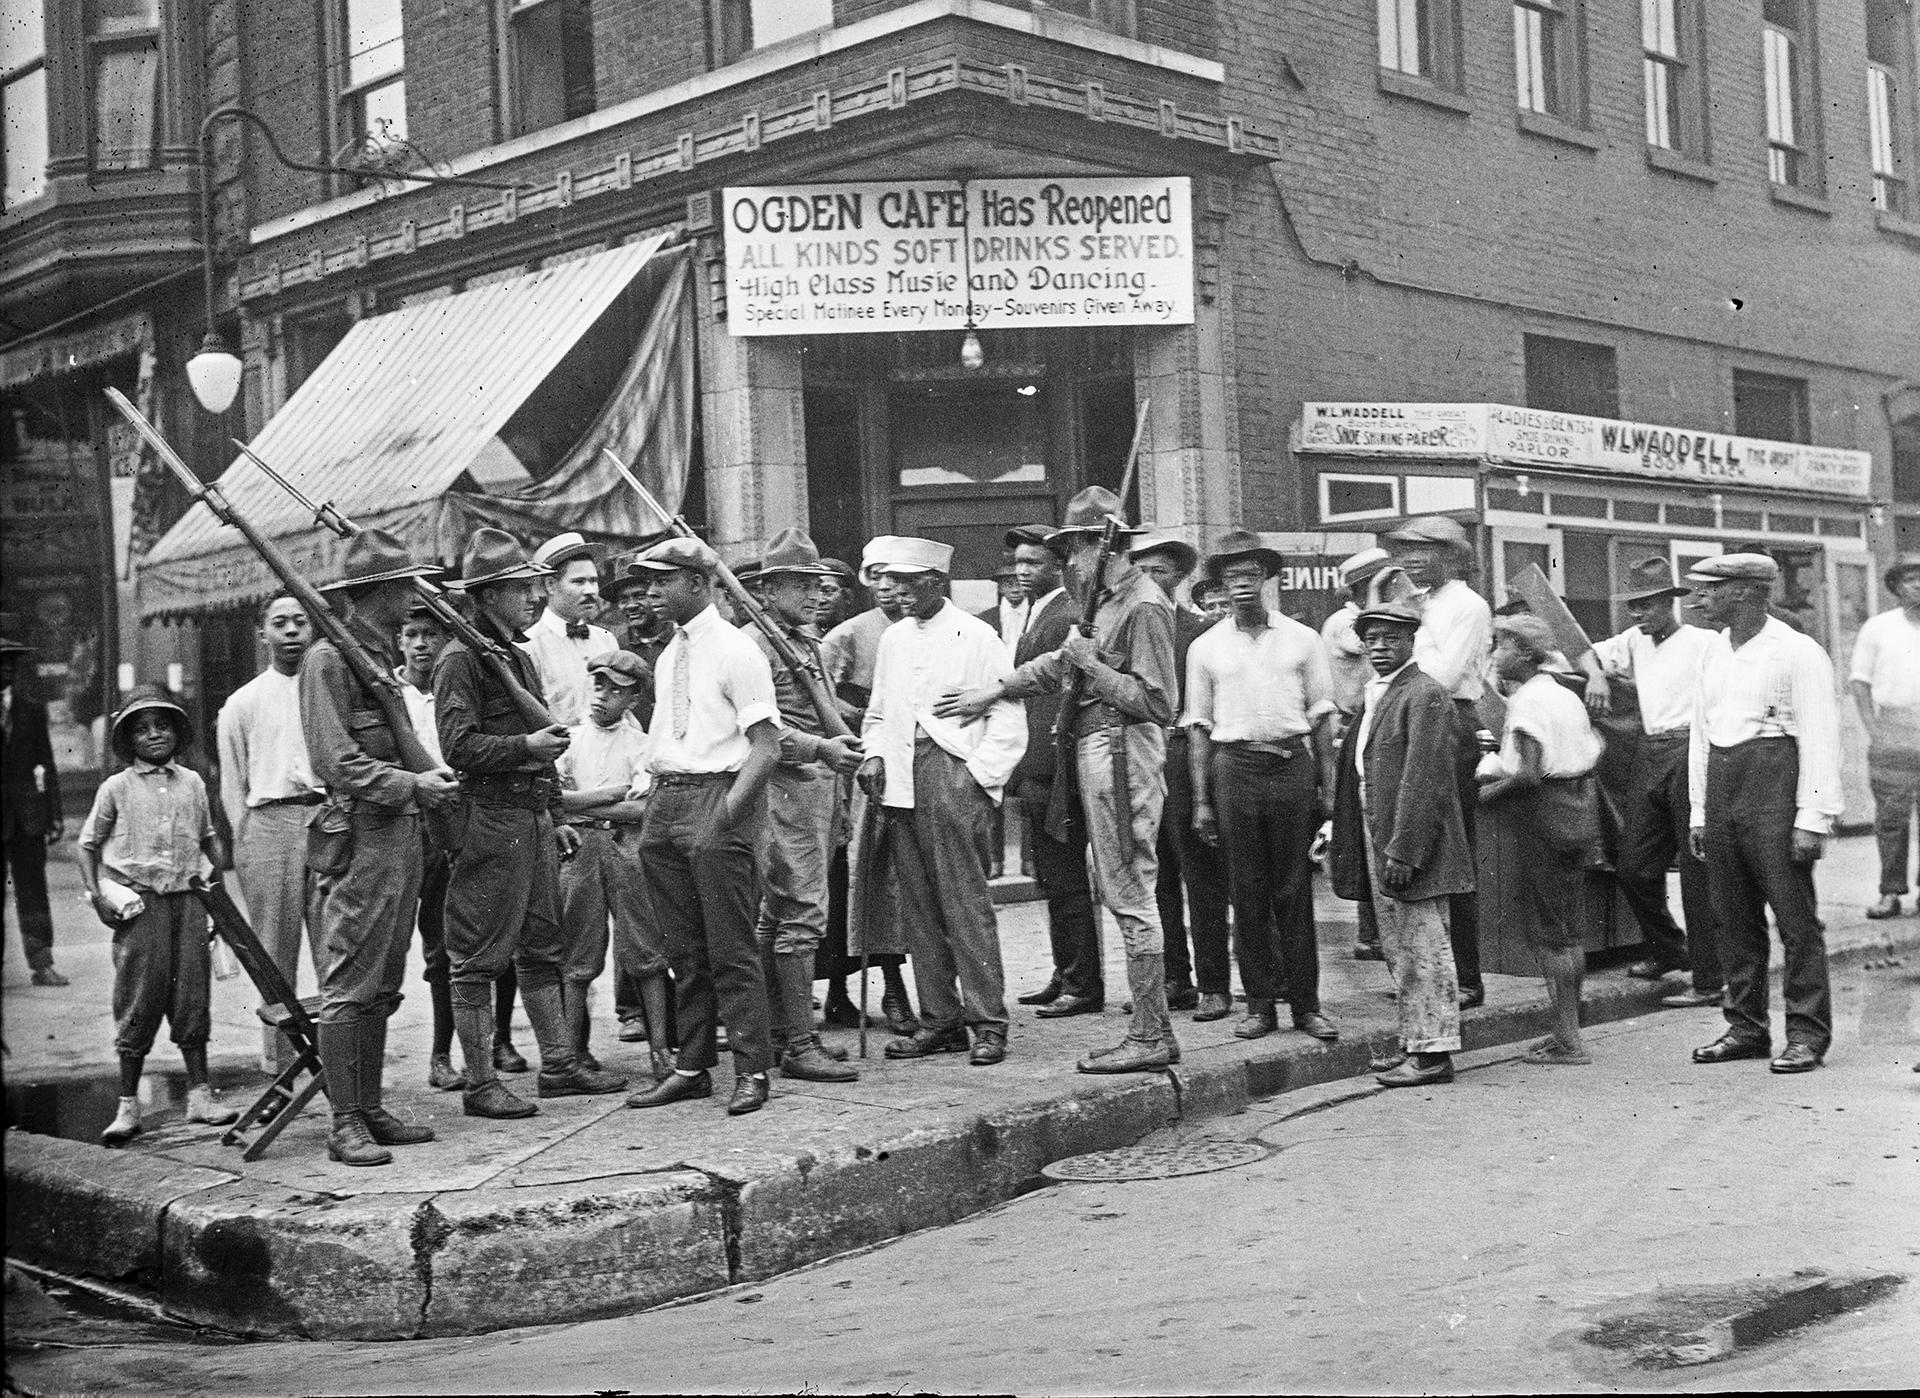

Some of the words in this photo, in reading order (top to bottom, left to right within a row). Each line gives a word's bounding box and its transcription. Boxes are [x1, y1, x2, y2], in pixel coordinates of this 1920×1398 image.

[733, 193, 863, 234] OGDEN
[879, 189, 966, 229] CAFE
[982, 190, 1036, 227] Has
[1040, 183, 1172, 234] Reopened
[740, 243, 784, 270] ALL
[797, 239, 880, 268] KINDS
[894, 238, 959, 265] SOFT
[973, 236, 1071, 263] DRINKS
[740, 274, 800, 304] High
[809, 274, 876, 296] Class
[971, 268, 1018, 291] and
[746, 303, 805, 327] Special
[814, 302, 876, 319] Matinee
[883, 301, 928, 324] Every
[1084, 297, 1126, 315] Given
[1508, 440, 1570, 459] PARLOR
